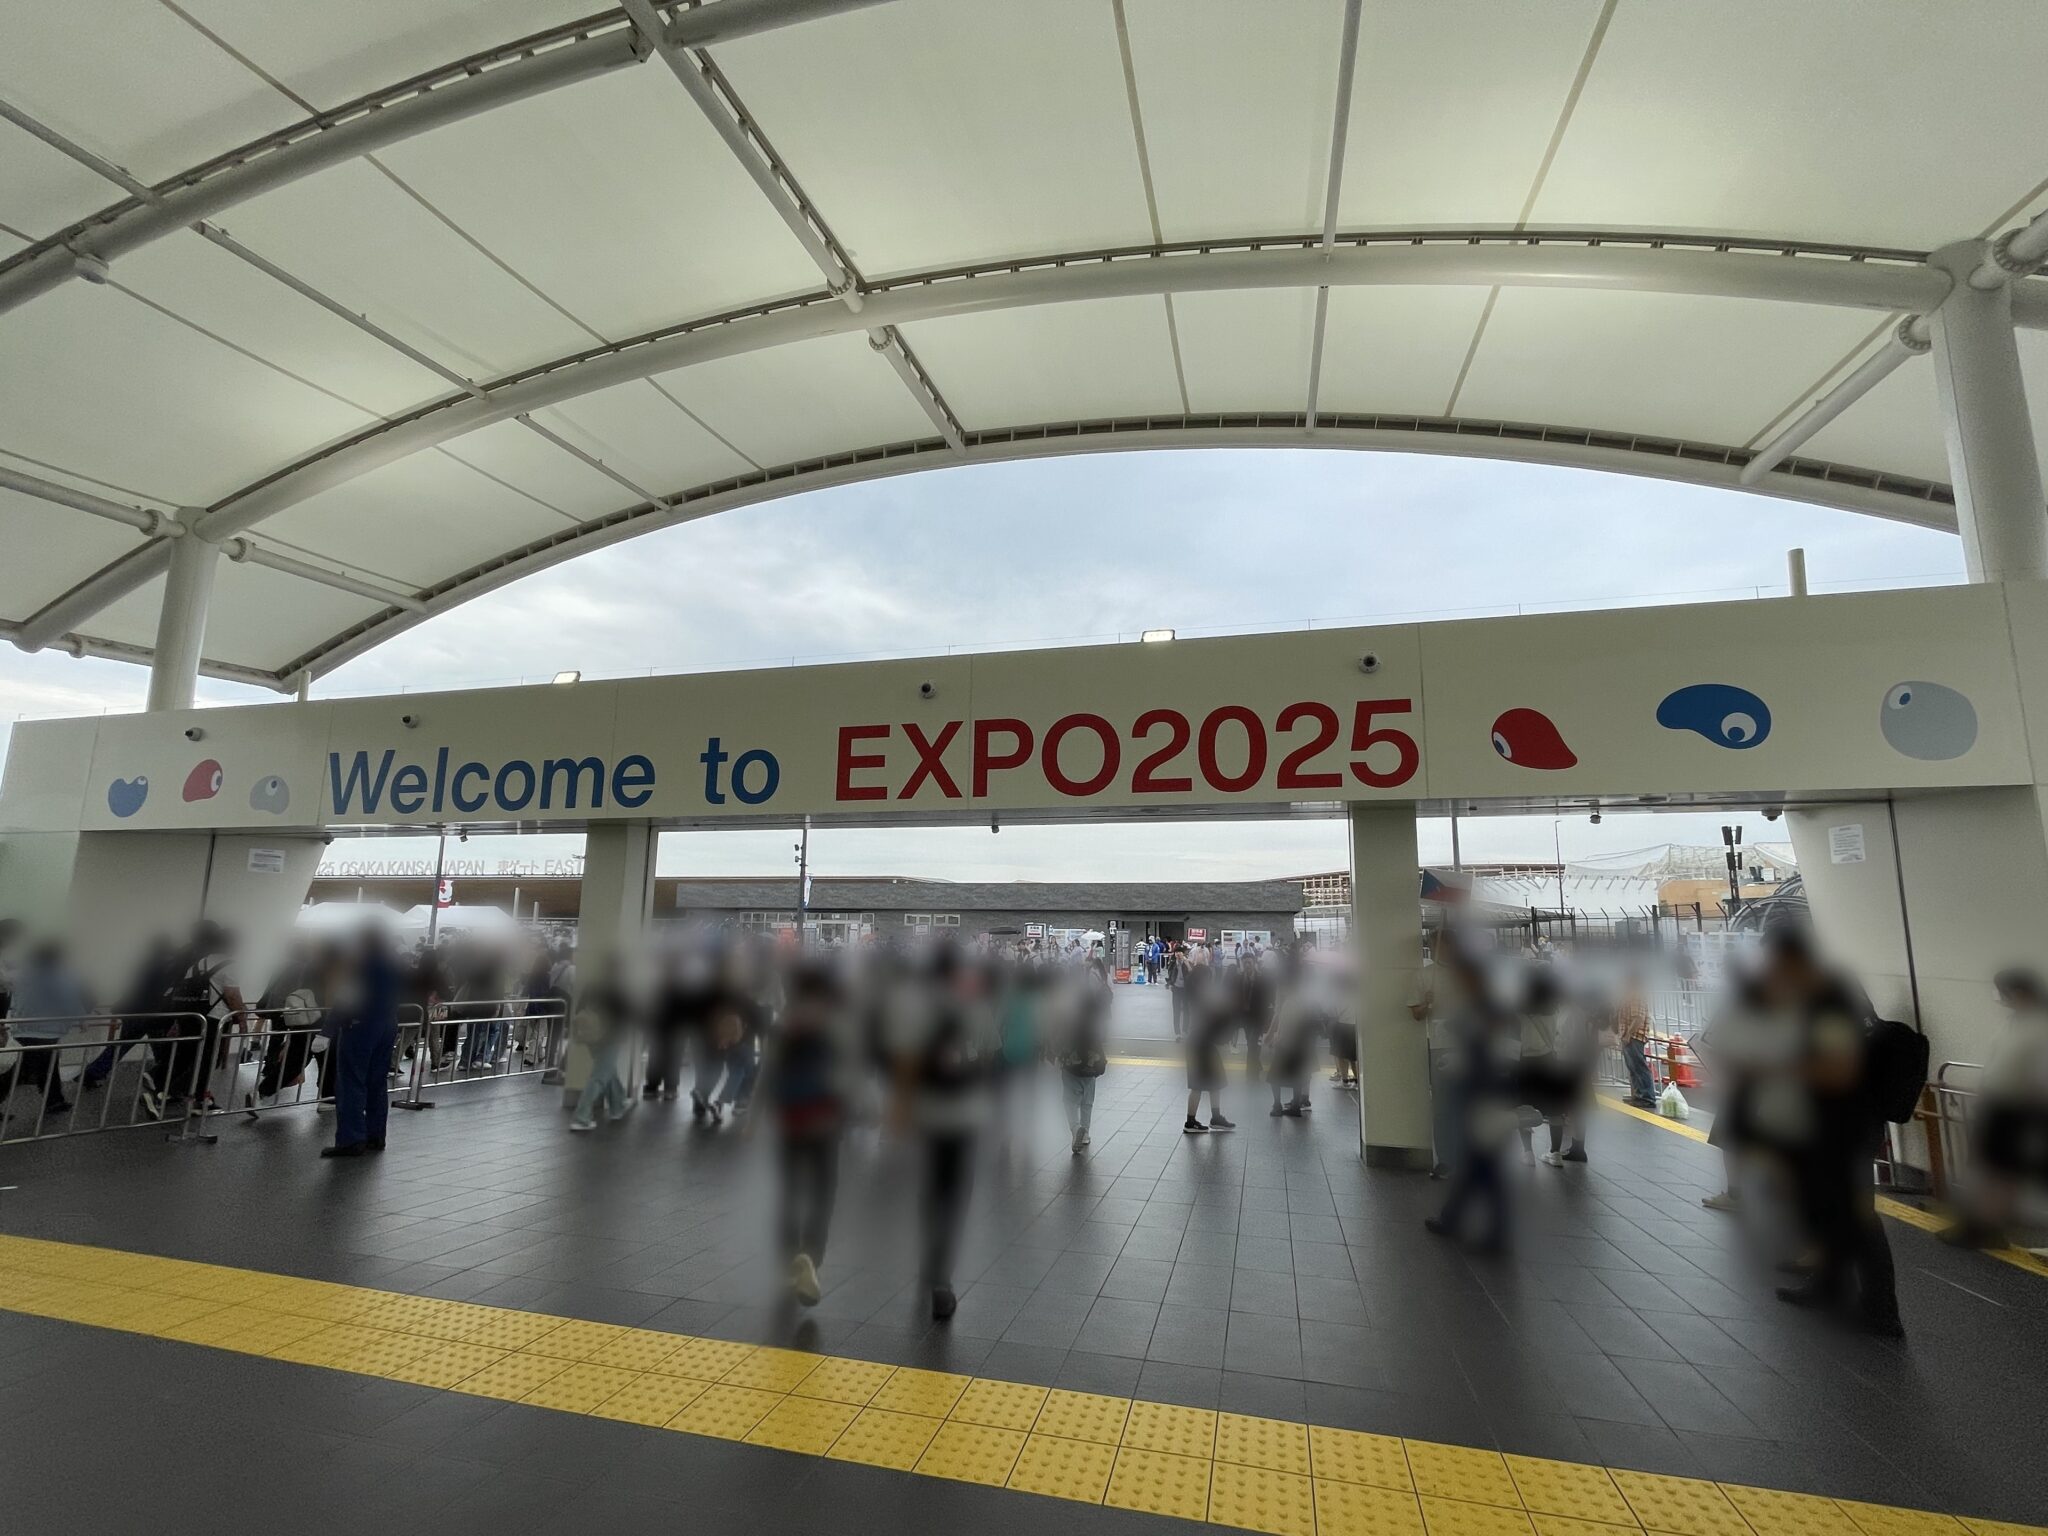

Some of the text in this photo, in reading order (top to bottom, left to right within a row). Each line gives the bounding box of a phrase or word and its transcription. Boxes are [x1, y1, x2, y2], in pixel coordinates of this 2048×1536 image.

[329, 697, 1419, 815] Welcome to EXPO2025
[340, 861, 384, 875] OSAKA
[545, 859, 583, 875] EAST
